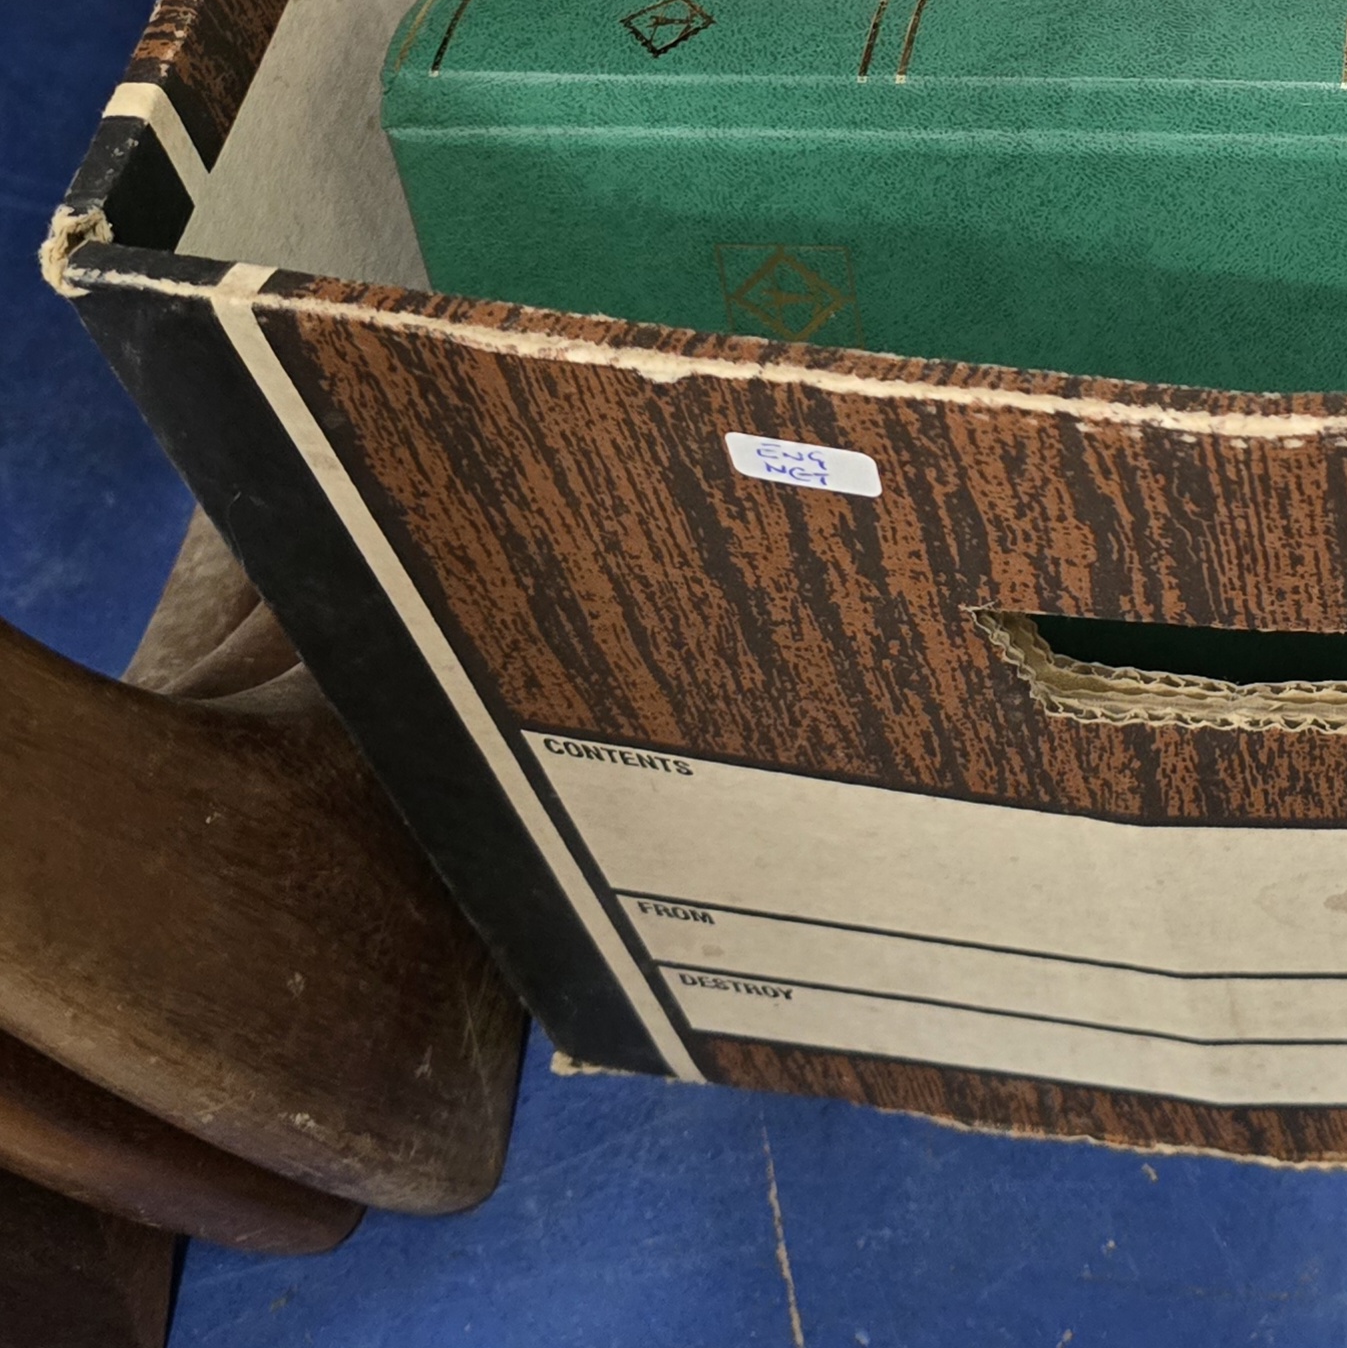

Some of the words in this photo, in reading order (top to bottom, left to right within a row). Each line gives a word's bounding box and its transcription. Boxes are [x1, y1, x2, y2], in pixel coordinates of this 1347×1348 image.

[543, 736, 695, 777] CONTENTS
[637, 900, 716, 925] FROM
[679, 972, 794, 1001] DESTROY
